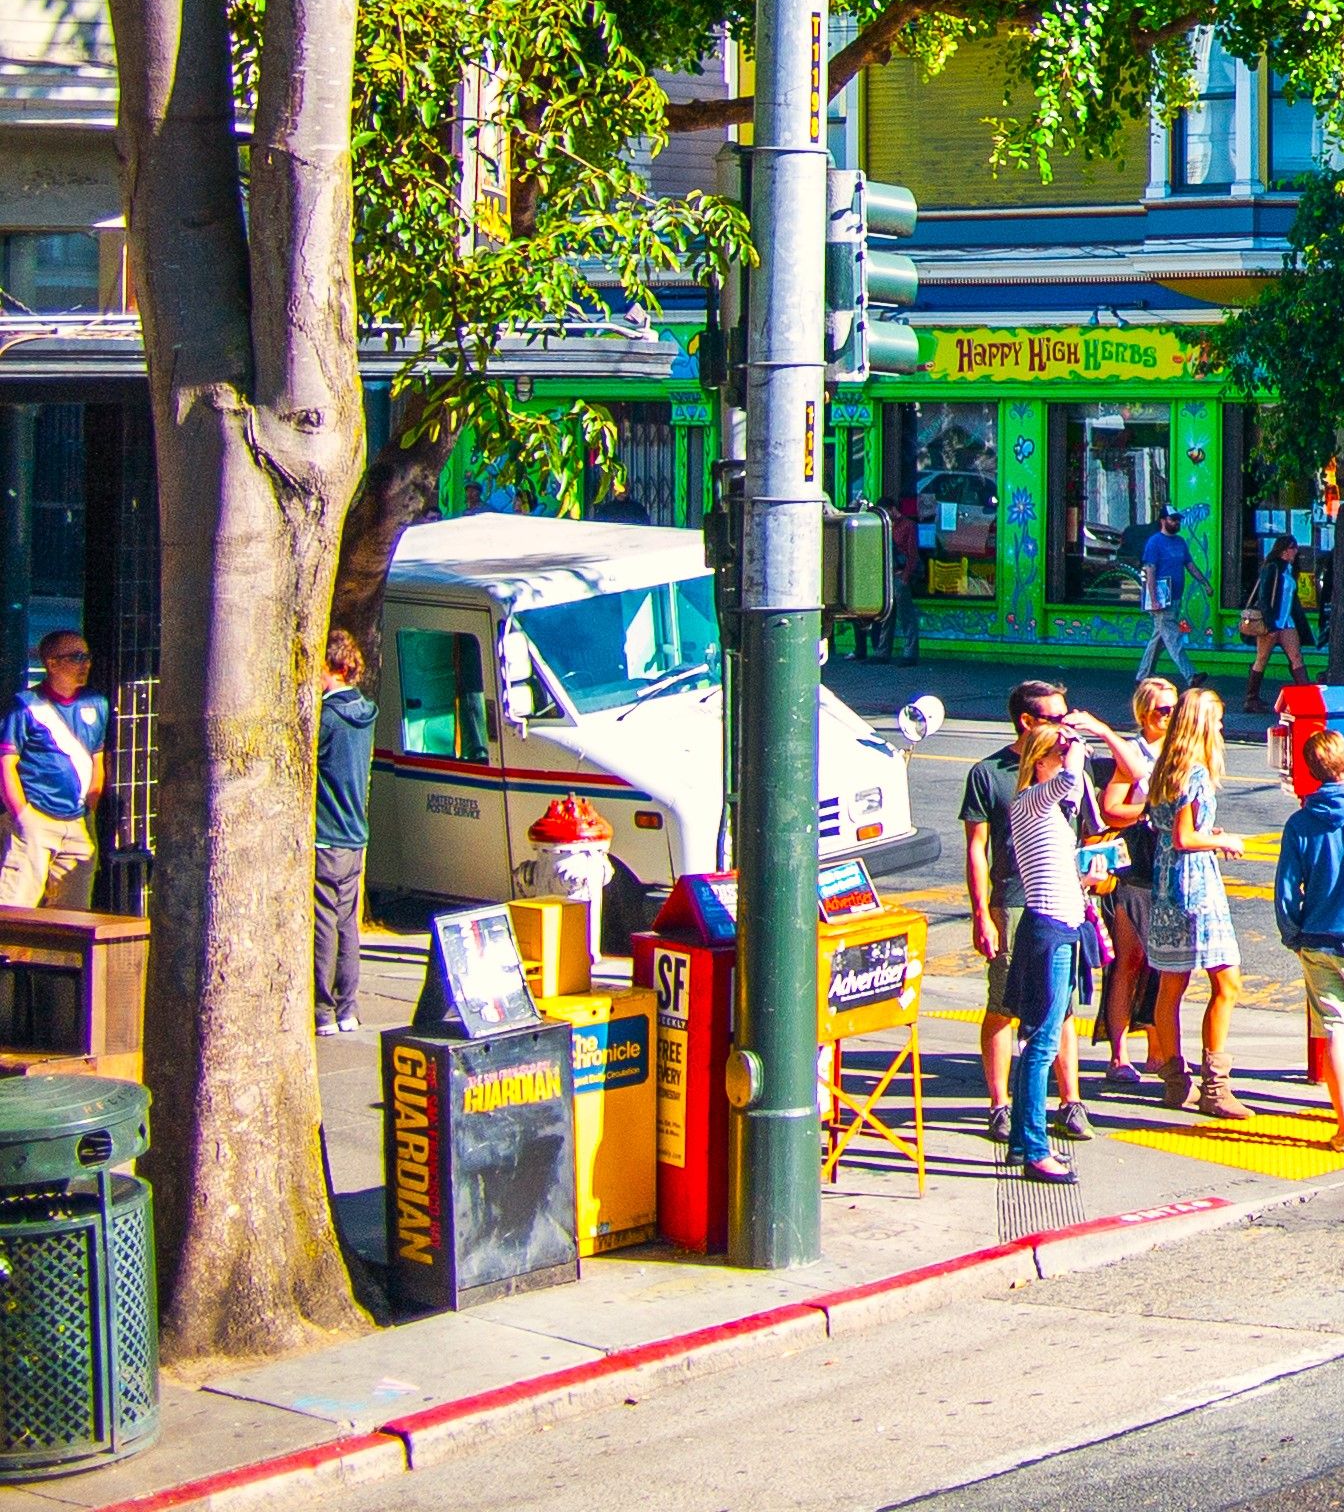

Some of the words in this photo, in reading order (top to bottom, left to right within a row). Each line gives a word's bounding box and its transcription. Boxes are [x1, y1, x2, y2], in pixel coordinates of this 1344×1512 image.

[823, 890, 873, 913] Advertiser
[657, 954, 686, 1012] SF
[828, 960, 905, 999] Advertiser
[659, 1016, 686, 1030] EEKLY
[463, 1064, 562, 1114] GUARDIAN
[392, 1045, 434, 1266] GUARDIAN
